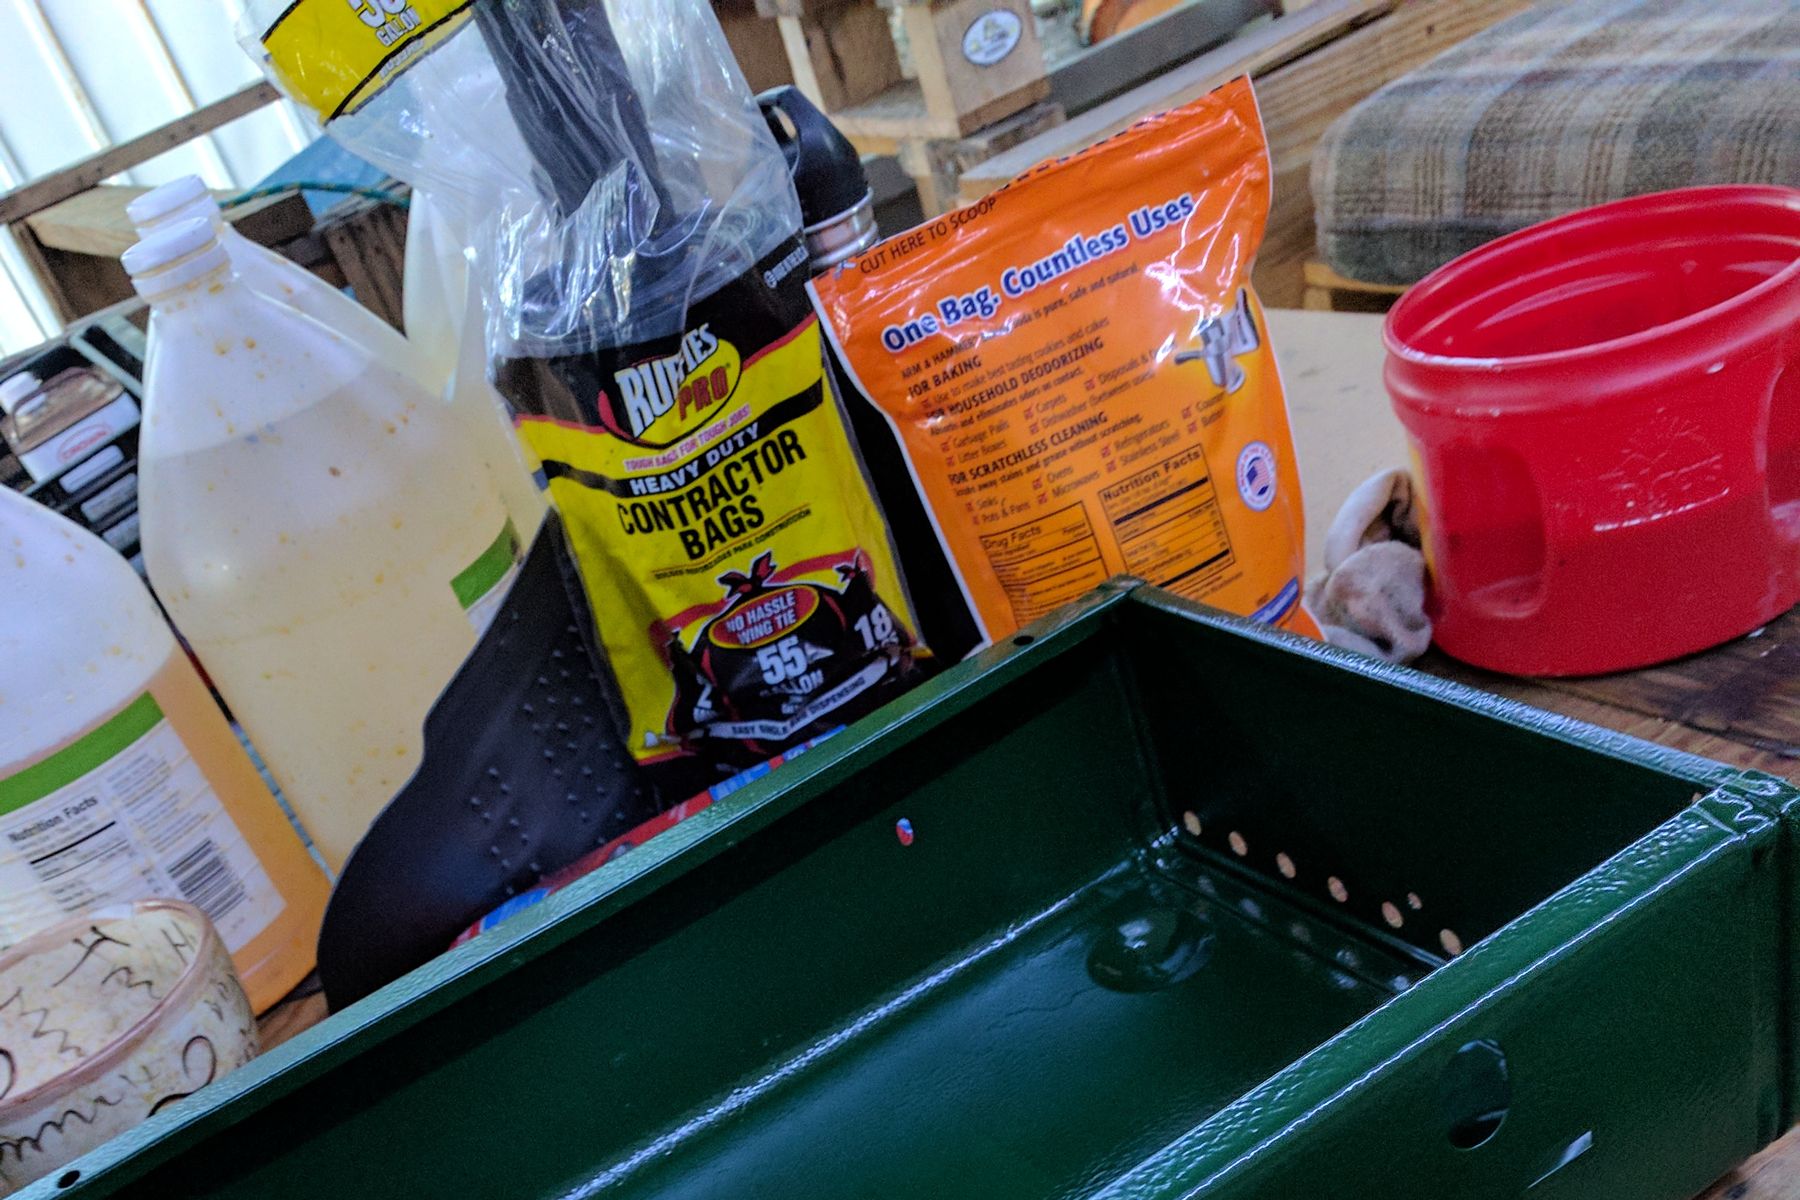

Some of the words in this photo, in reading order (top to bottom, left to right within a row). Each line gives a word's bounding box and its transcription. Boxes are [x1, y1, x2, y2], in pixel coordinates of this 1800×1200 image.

[860, 252, 885, 275] CUT
[888, 232, 925, 262] HERE
[928, 221, 947, 238] TO
[949, 197, 997, 229] SCOOP
[881, 315, 938, 353] One
[1002, 228, 1127, 296] Countless
[1131, 193, 1196, 240] Uses
[678, 366, 728, 421] PRO
[909, 381, 929, 398] FOR
[932, 356, 981, 385] BAKING
[949, 376, 1019, 416] HOUSEHOLD
[1020, 337, 1104, 383] DEODORIZING
[629, 460, 700, 495] HEAVY
[705, 422, 759, 467] DUTY
[969, 436, 1049, 482] SCRATCHLESS
[1049, 410, 1108, 446] CLEANING
[617, 429, 807, 536] CONTRACTOR
[1103, 471, 1160, 500] Nutrition
[1164, 450, 1200, 473] Facts
[679, 494, 765, 560] BAGS
[1011, 527, 1041, 542] Facts
[726, 616, 745, 633] NO
[749, 591, 796, 626] HASSLE
[737, 622, 773, 645] WING
[774, 611, 796, 630] TIE
[854, 603, 893, 650] 18
[756, 634, 808, 686] 55
[8, 814, 62, 842] Nutrition
[64, 795, 98, 818] Facts
